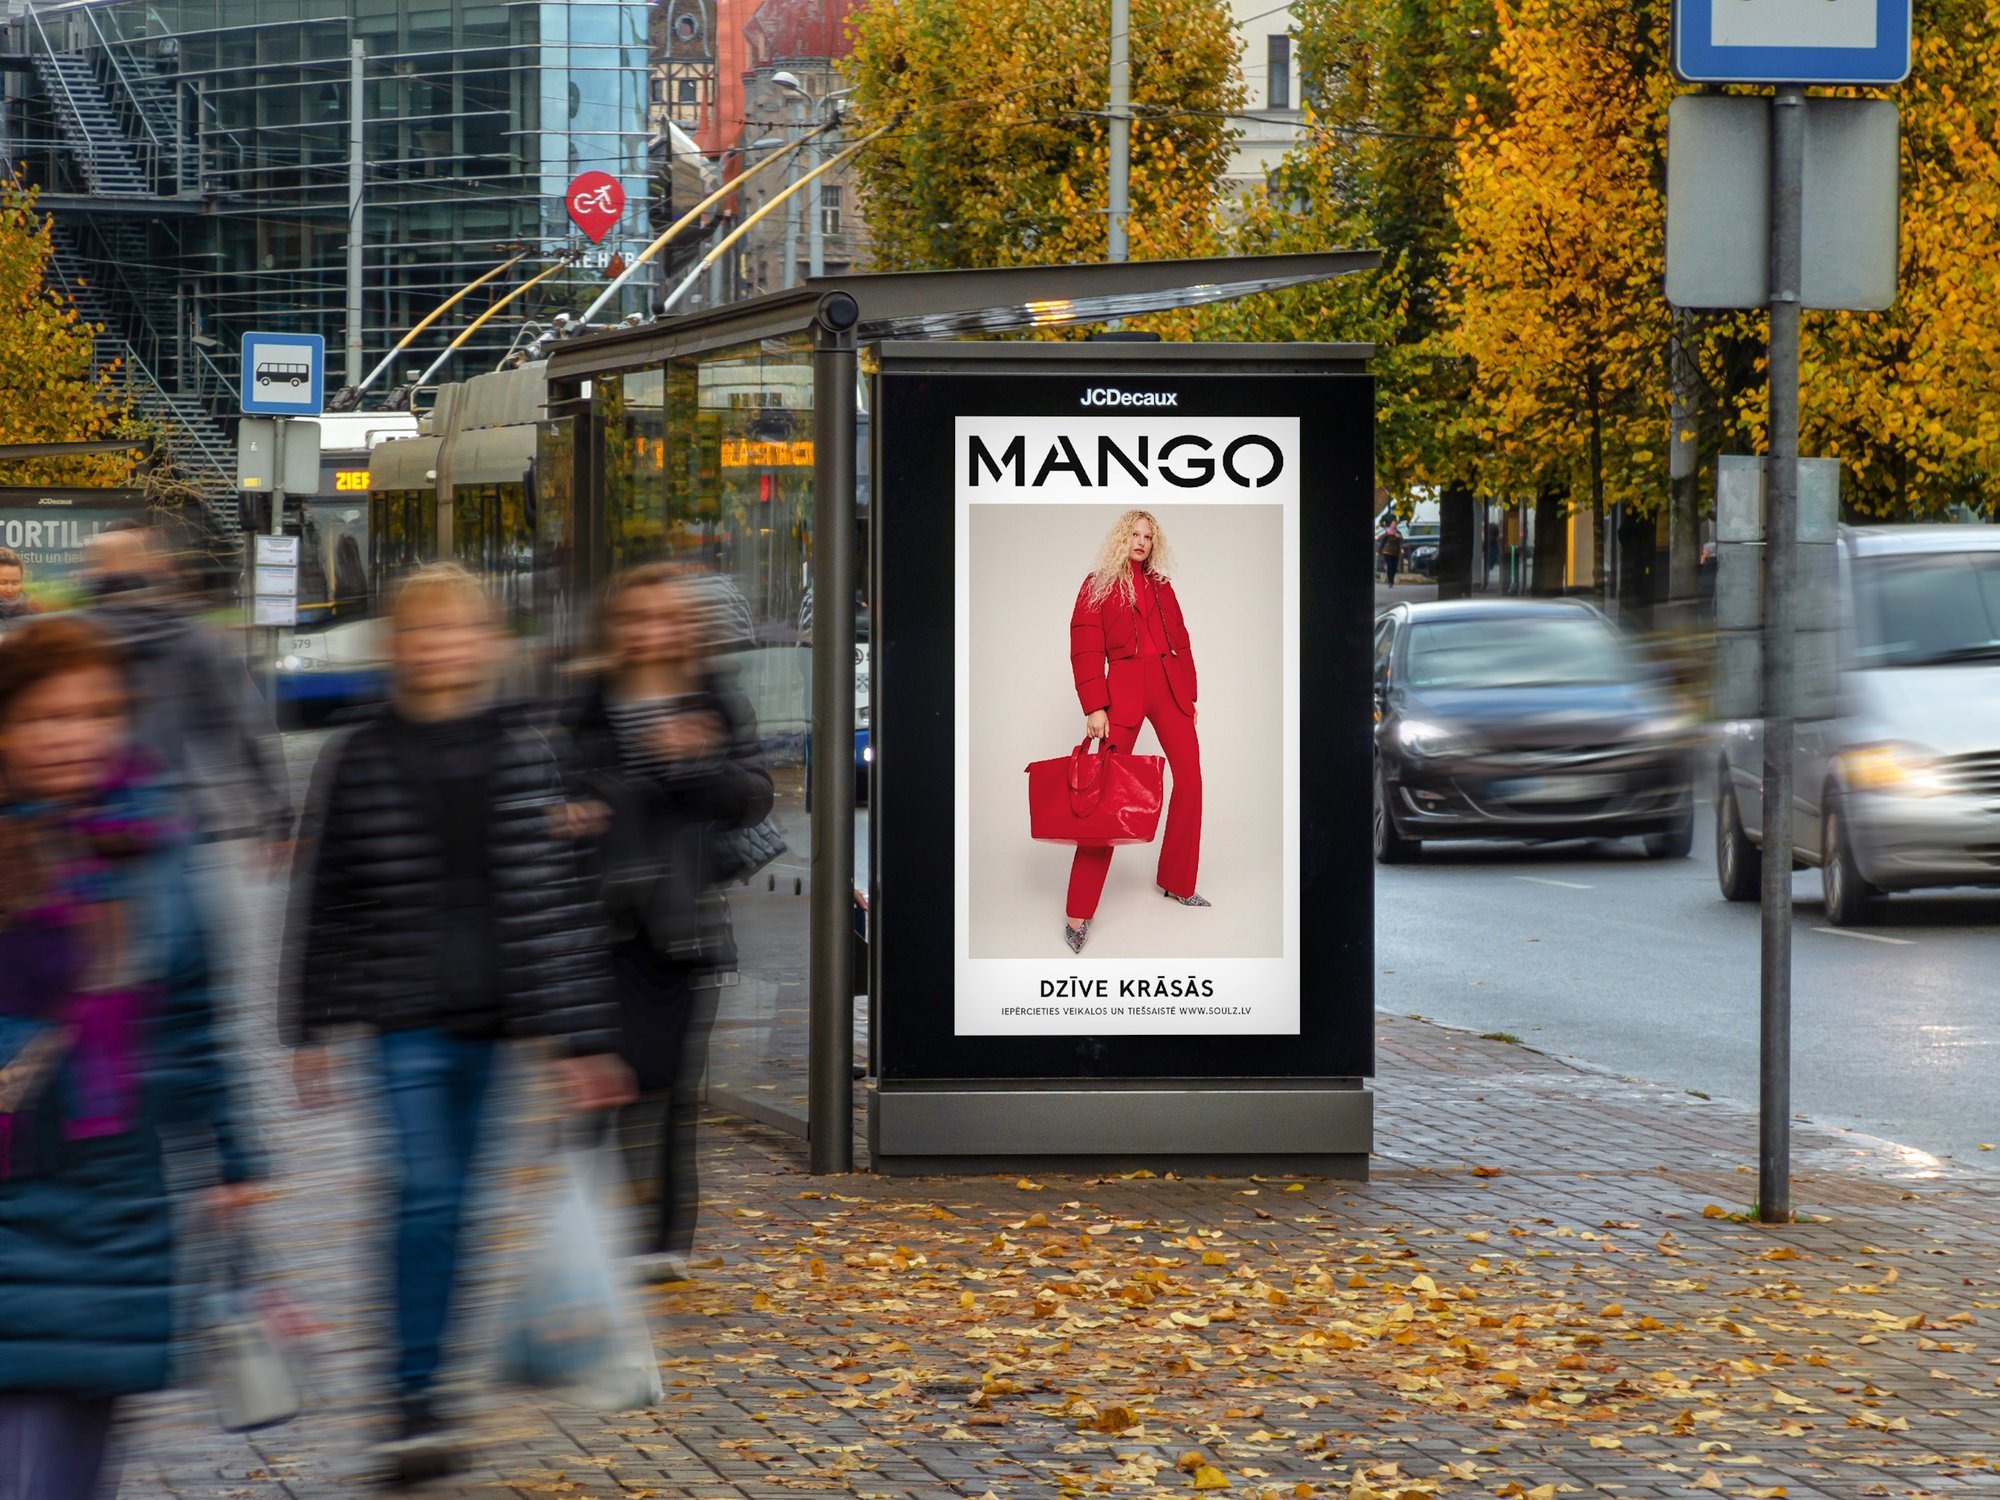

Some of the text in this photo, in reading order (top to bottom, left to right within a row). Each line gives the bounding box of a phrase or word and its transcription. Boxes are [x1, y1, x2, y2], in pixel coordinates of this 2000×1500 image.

[1080, 388, 1178, 406] JCDecaux
[968, 434, 1284, 489] MANGO
[45, 553, 61, 564] un
[1040, 975, 1214, 998] DZĪVE KRĀSĀS
[1001, 1005, 1252, 1016] IEPĒRCIETIES VEIKALOS UN TIEŠSAISTĒ WWW.SOULZ.LV
